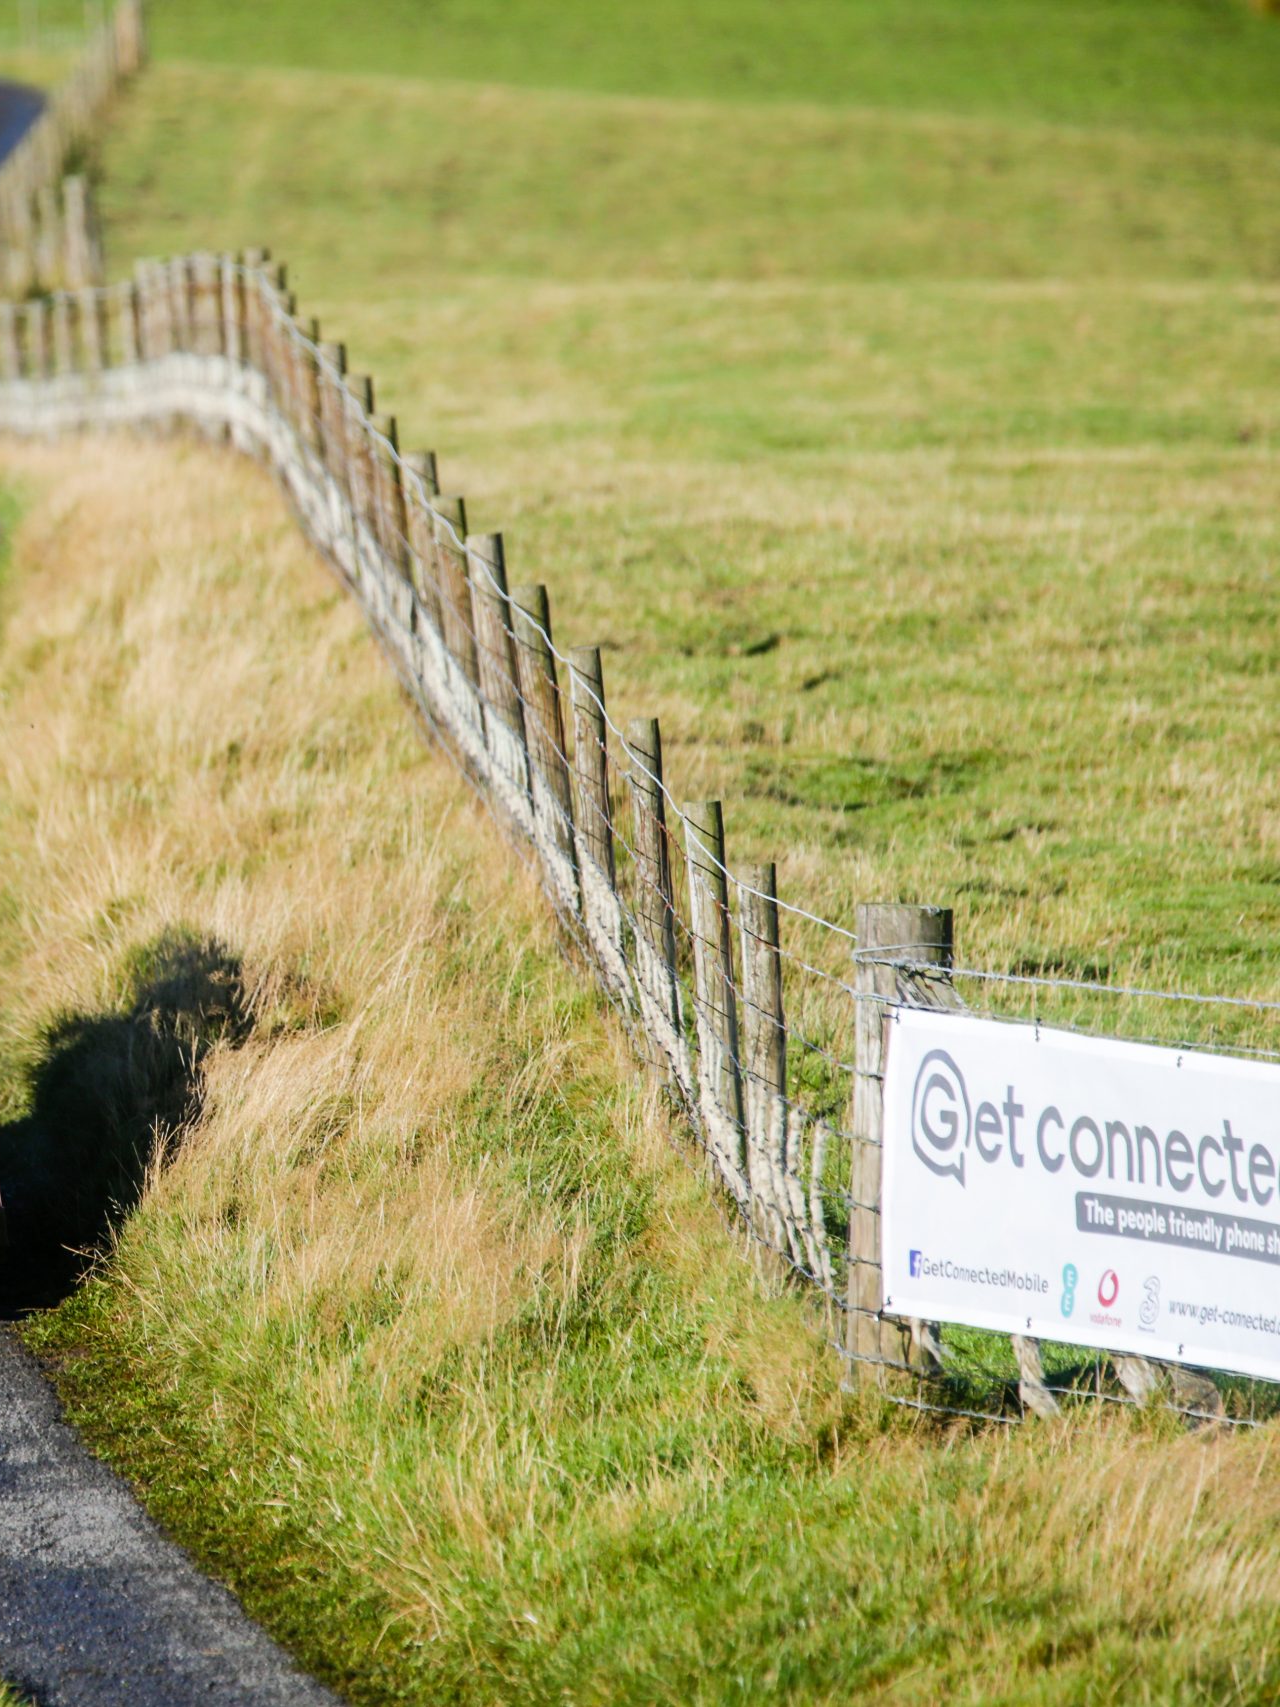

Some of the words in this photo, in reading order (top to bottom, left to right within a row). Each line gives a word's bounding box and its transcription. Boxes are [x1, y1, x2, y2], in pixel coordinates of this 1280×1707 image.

[920, 1073, 1025, 1168] Get
[1036, 1105, 1280, 1207] connecte
[1084, 1199, 1115, 1226] The
[1118, 1208, 1166, 1237] people
[1169, 1211, 1223, 1250] friendly
[1226, 1221, 1265, 1251] phone
[922, 1258, 1049, 1293] GetConnectedMobile
[1089, 1313, 1122, 1328] vodafone
